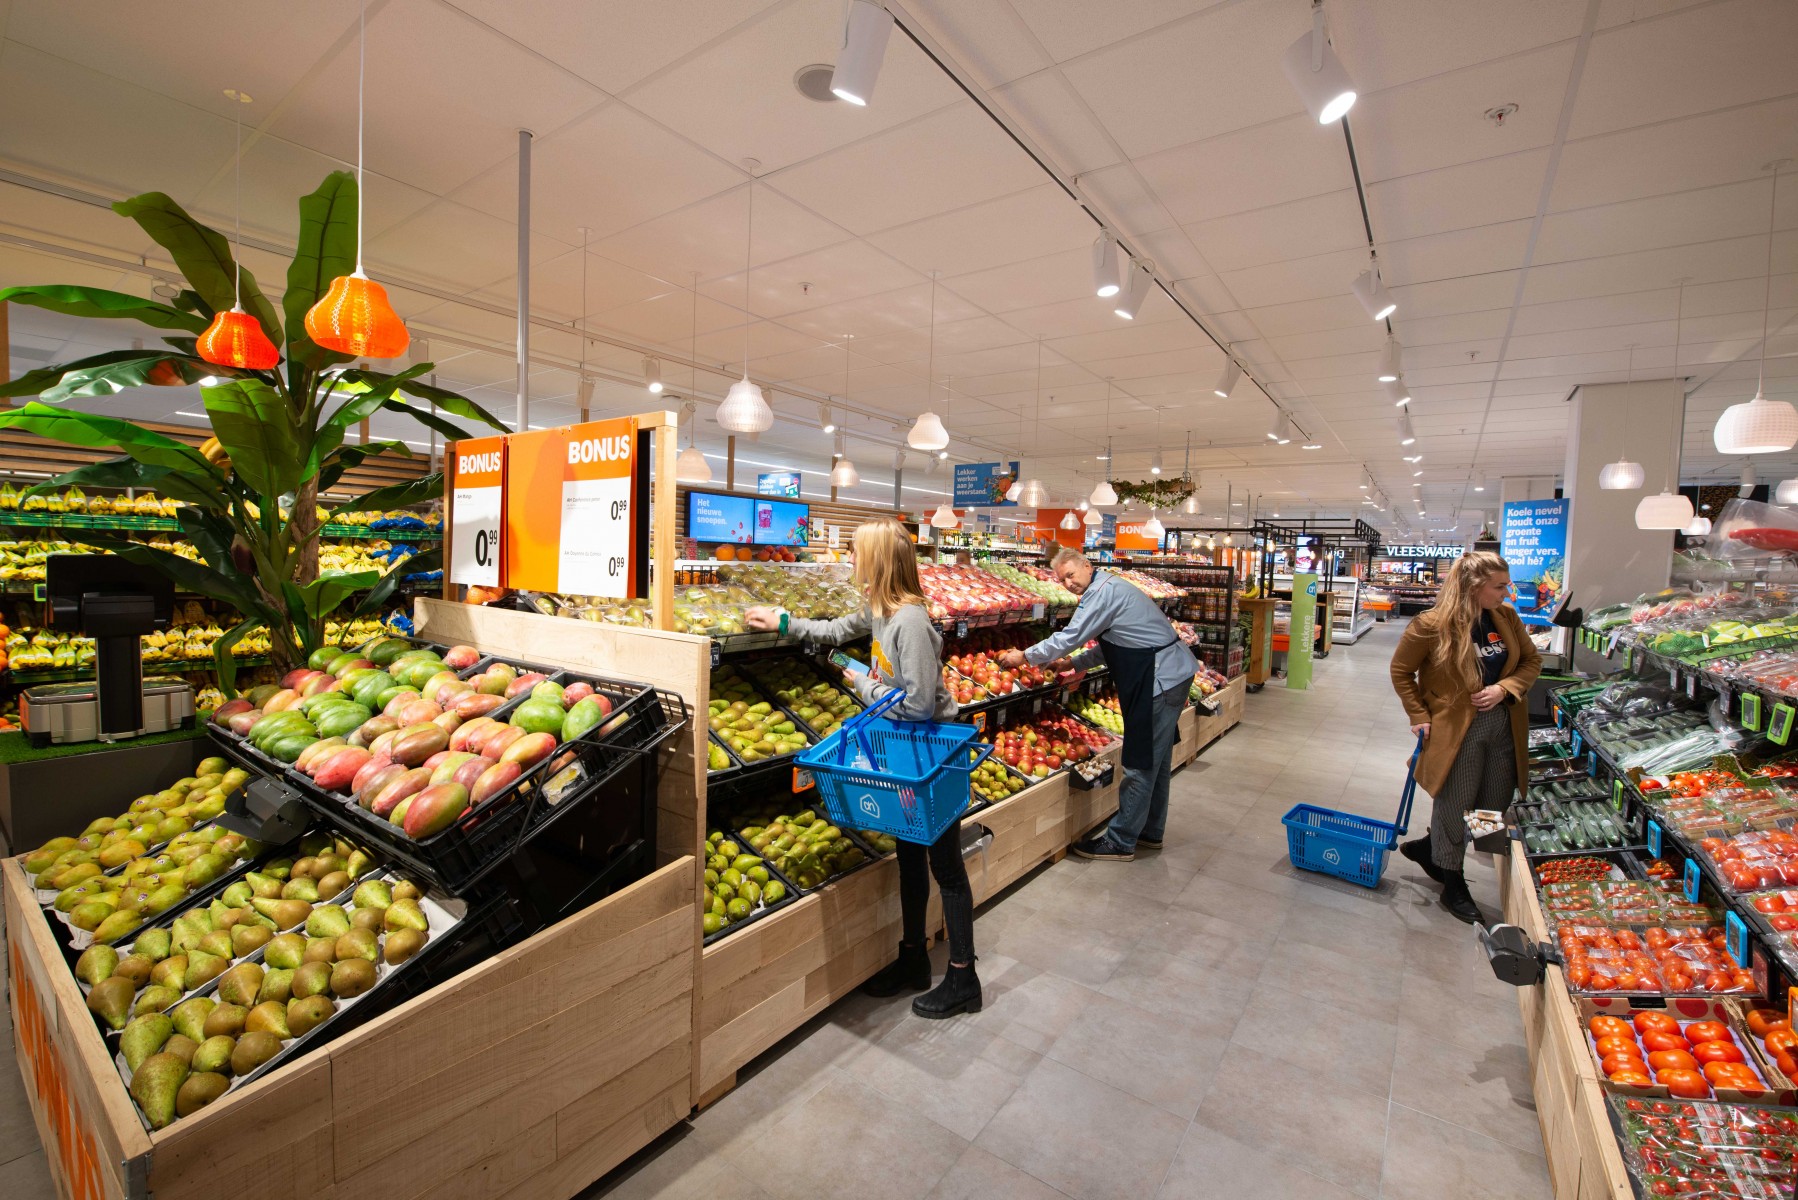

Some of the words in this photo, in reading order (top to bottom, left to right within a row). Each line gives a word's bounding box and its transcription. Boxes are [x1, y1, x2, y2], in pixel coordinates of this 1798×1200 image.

[568, 435, 630, 464] BONUS
[459, 451, 501, 474] BONUS
[697, 498, 710, 507] Het
[611, 500, 627, 520] 0.99
[697, 507, 722, 516] nieuwe
[1507, 507, 1533, 517] Koele
[1535, 505, 1562, 516] nevel
[697, 517, 728, 526] snoepen.
[1506, 517, 1533, 526] houdt
[1535, 517, 1559, 525] onze
[1119, 525, 1142, 535] BON
[1505, 527, 1542, 538] groente
[1505, 538, 1517, 546] en
[1519, 536, 1540, 546] fruit
[475, 529, 498, 567] 0.99
[1504, 546, 1534, 557] langer
[1536, 547, 1560, 556] vers.
[608, 556, 625, 576] 0.99
[1504, 556, 1525, 565] Cool
